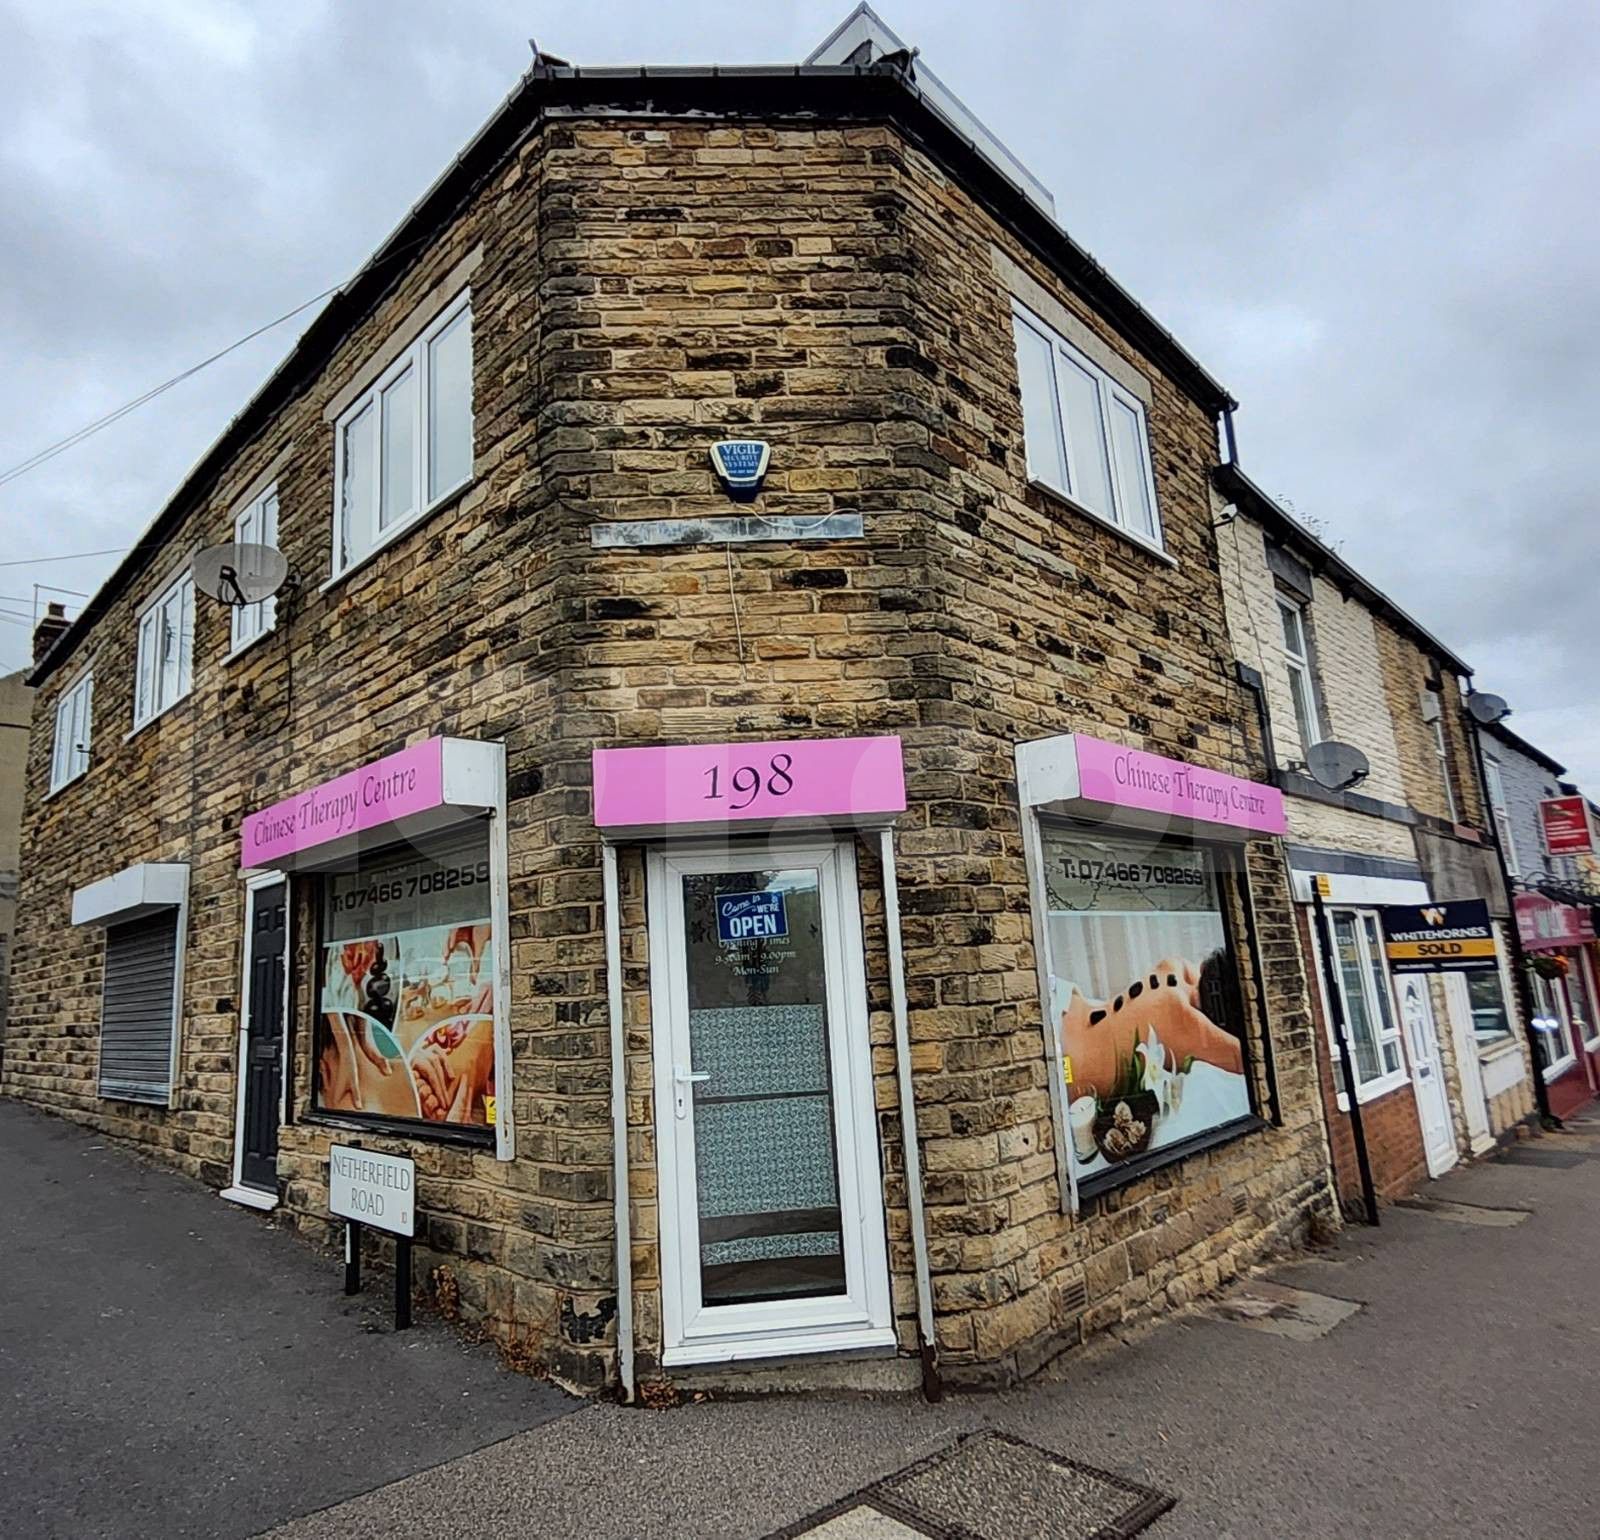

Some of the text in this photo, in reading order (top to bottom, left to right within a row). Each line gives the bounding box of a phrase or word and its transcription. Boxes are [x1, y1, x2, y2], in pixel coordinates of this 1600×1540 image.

[722, 444, 760, 455] VIGIL
[703, 753, 794, 810] 198
[1114, 751, 1266, 820] Chinese Therapy Centre
[253, 767, 417, 847] Chinese Therapy Centre
[406, 861, 490, 898] 708259
[722, 894, 761, 917] Come in
[757, 902, 780, 913] WE'RE
[729, 913, 778, 938] OPEN
[1390, 926, 1489, 942] WHITEHORNES
[1417, 942, 1462, 955] SOLD
[333, 1154, 411, 1192] NETHERFIELD
[351, 1187, 385, 1217] ROAD
